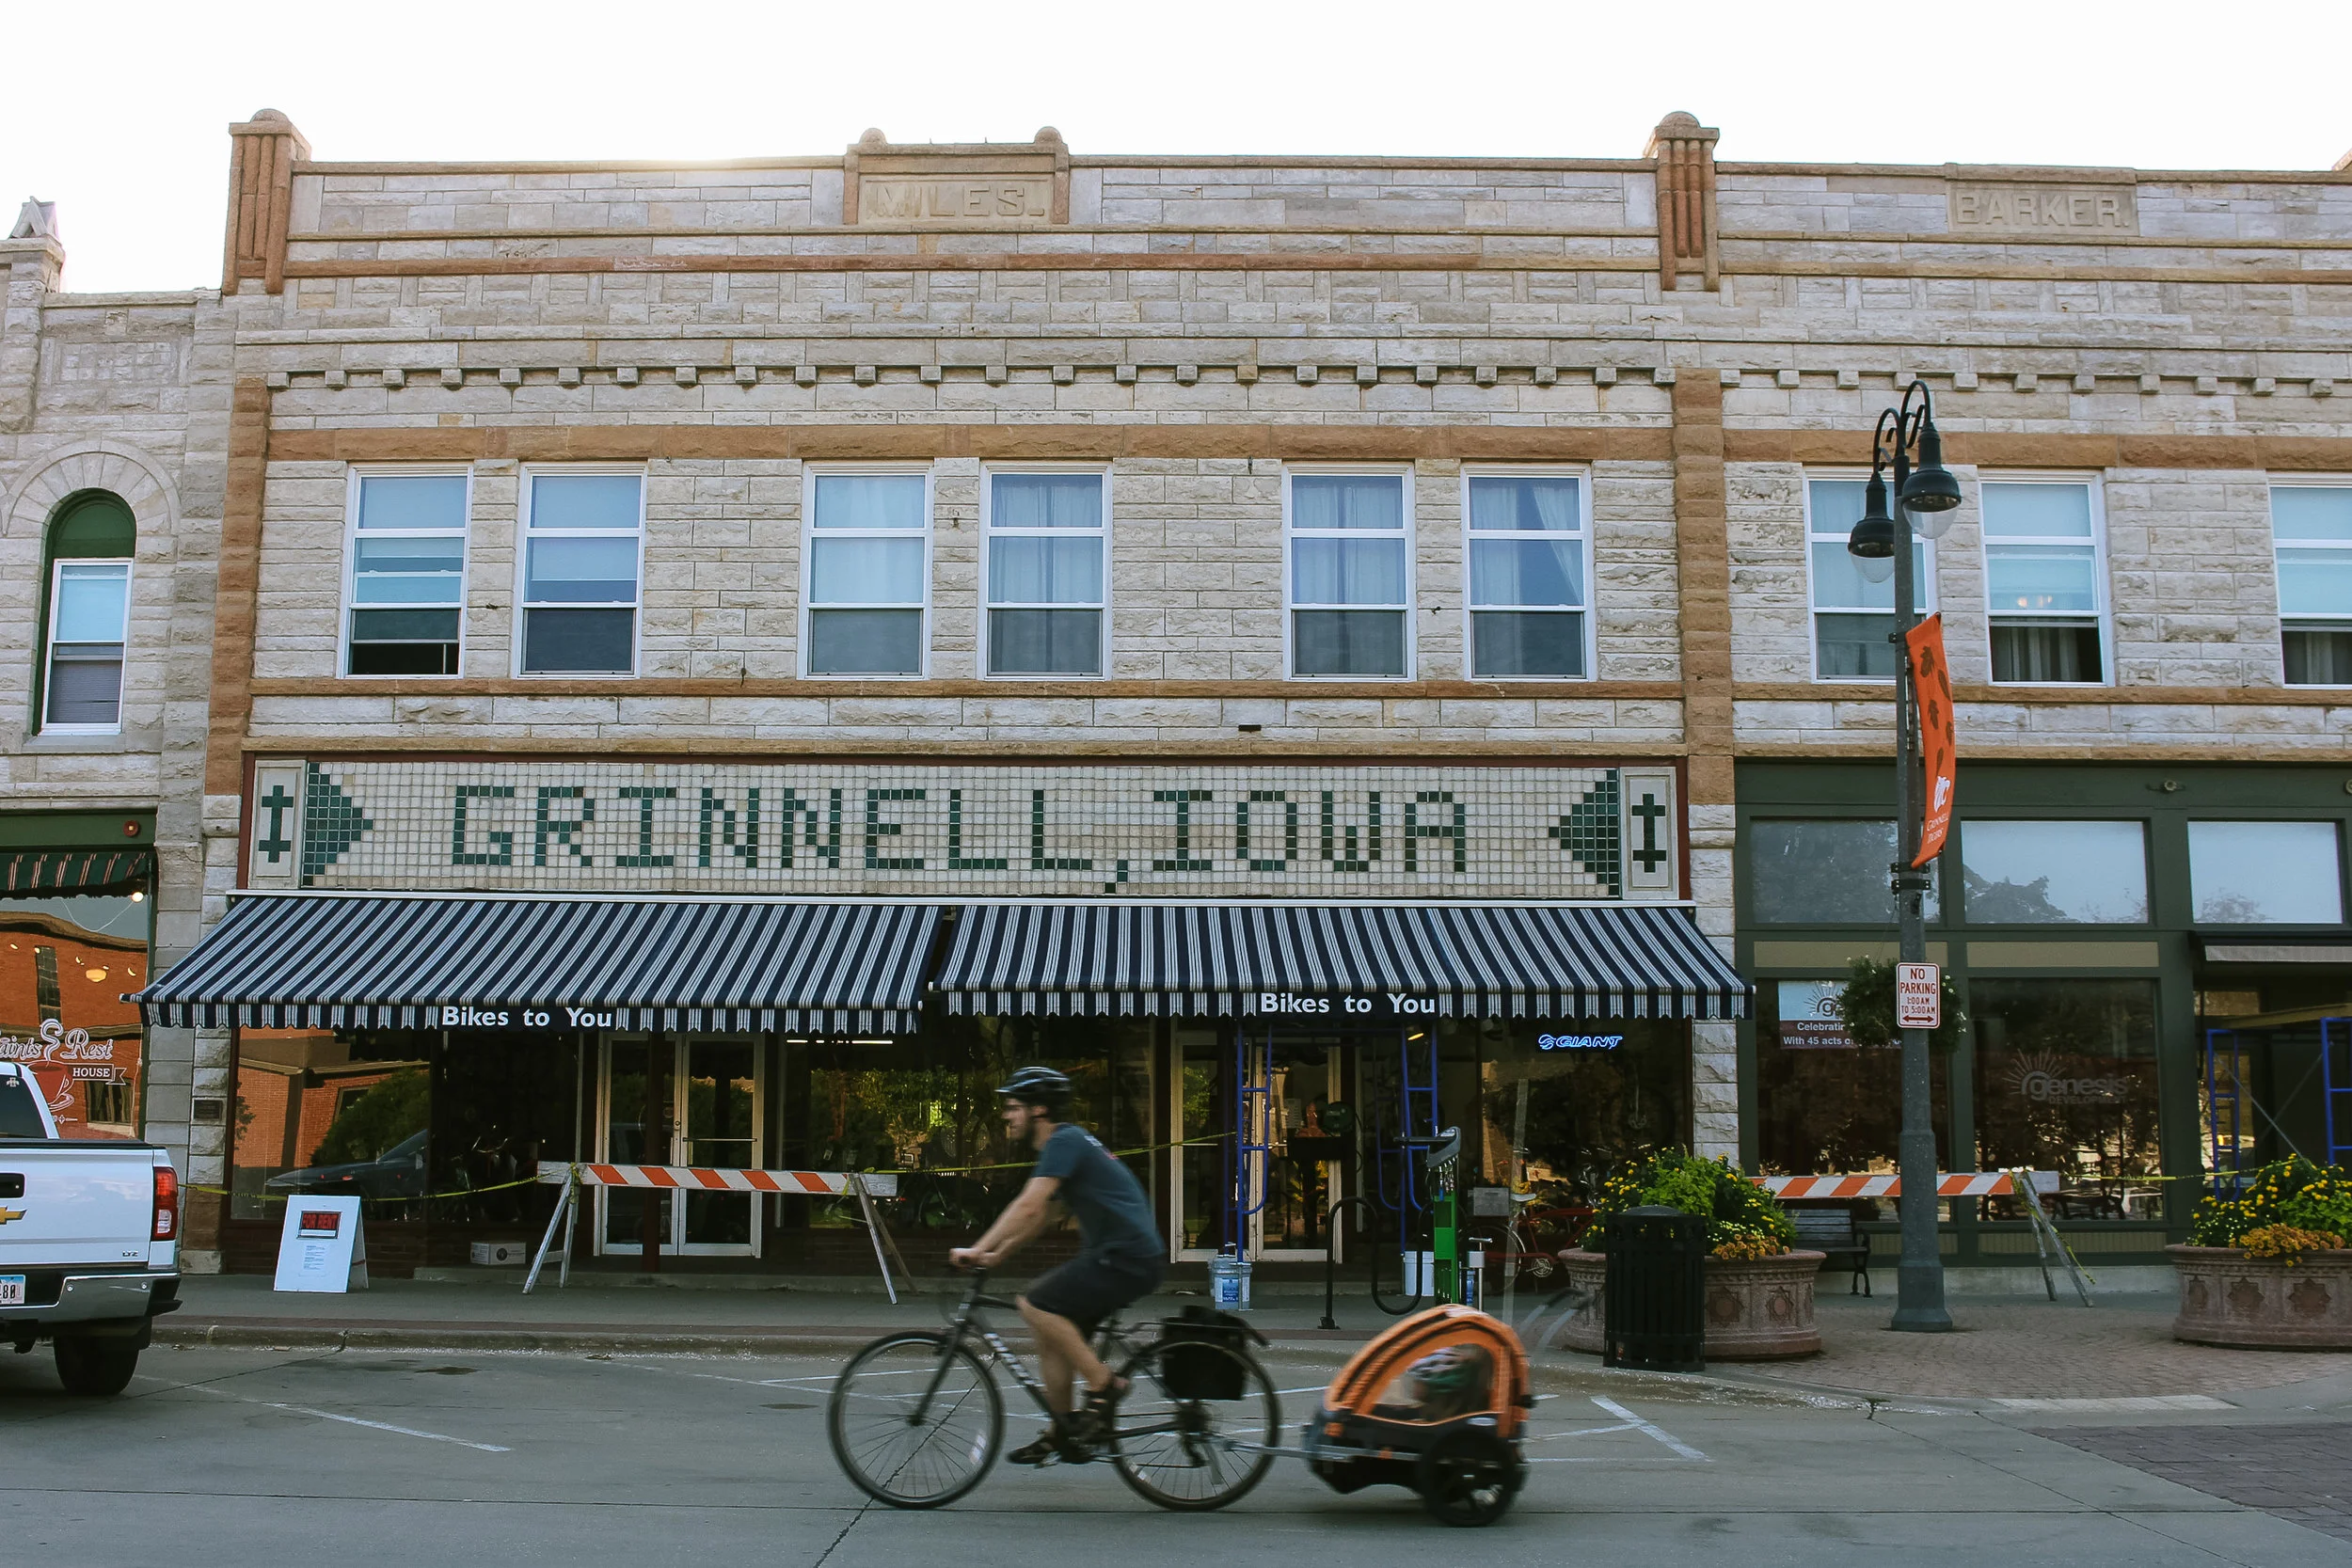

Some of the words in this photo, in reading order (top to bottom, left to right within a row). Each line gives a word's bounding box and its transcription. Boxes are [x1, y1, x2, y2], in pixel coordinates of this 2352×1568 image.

[1956, 193, 2130, 228] BARKER.
[1153, 789, 1466, 873] IOWA
[1910, 968, 1925, 979] NO
[1900, 982, 1935, 994] PARKING
[1261, 992, 1330, 1013] Bikes
[1344, 995, 1373, 1013] to
[1387, 992, 1436, 1014] You
[442, 1006, 509, 1027] Bikes
[522, 1008, 550, 1027] to
[565, 1006, 612, 1028] You
[0, 1036, 43, 1060] aints
[59, 1027, 113, 1060] Rest
[1555, 1035, 1623, 1050] GIANT
[1783, 1036, 1804, 1045] With
[1806, 1036, 1820, 1045] 45
[1821, 1036, 1842, 1045] acts
[72, 1067, 111, 1078] HOUSE
[2028, 1071, 2128, 1101] genesis
[302, 1212, 317, 1229] FOR
[318, 1213, 338, 1229] RENT
[0, 1284, 16, 1299] 80
